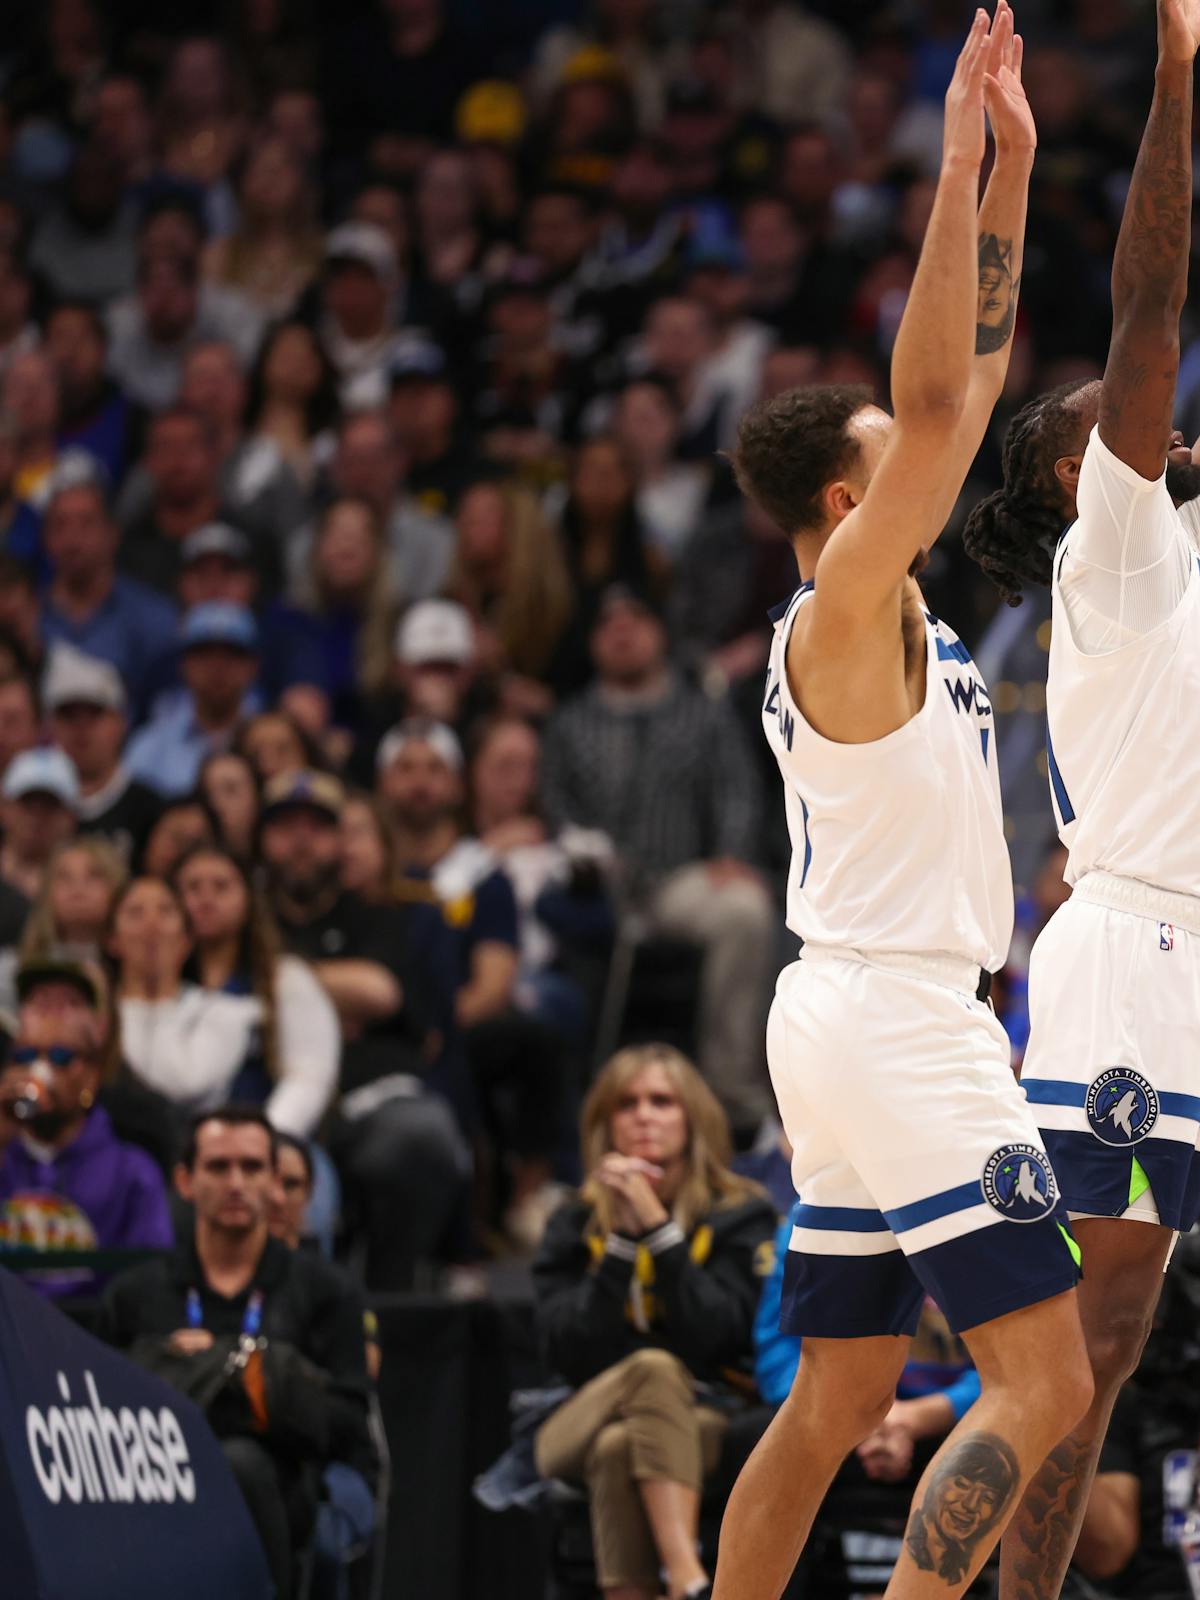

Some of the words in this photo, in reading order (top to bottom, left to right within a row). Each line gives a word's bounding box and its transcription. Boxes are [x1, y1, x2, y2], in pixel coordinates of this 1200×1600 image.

[1087, 1069, 1120, 1115] MINNESOTA
[1124, 1069, 1157, 1135] TIMBERWOLVES
[984, 1150, 1006, 1207] MINNESOTA
[26, 1369, 196, 1504] coinbase
